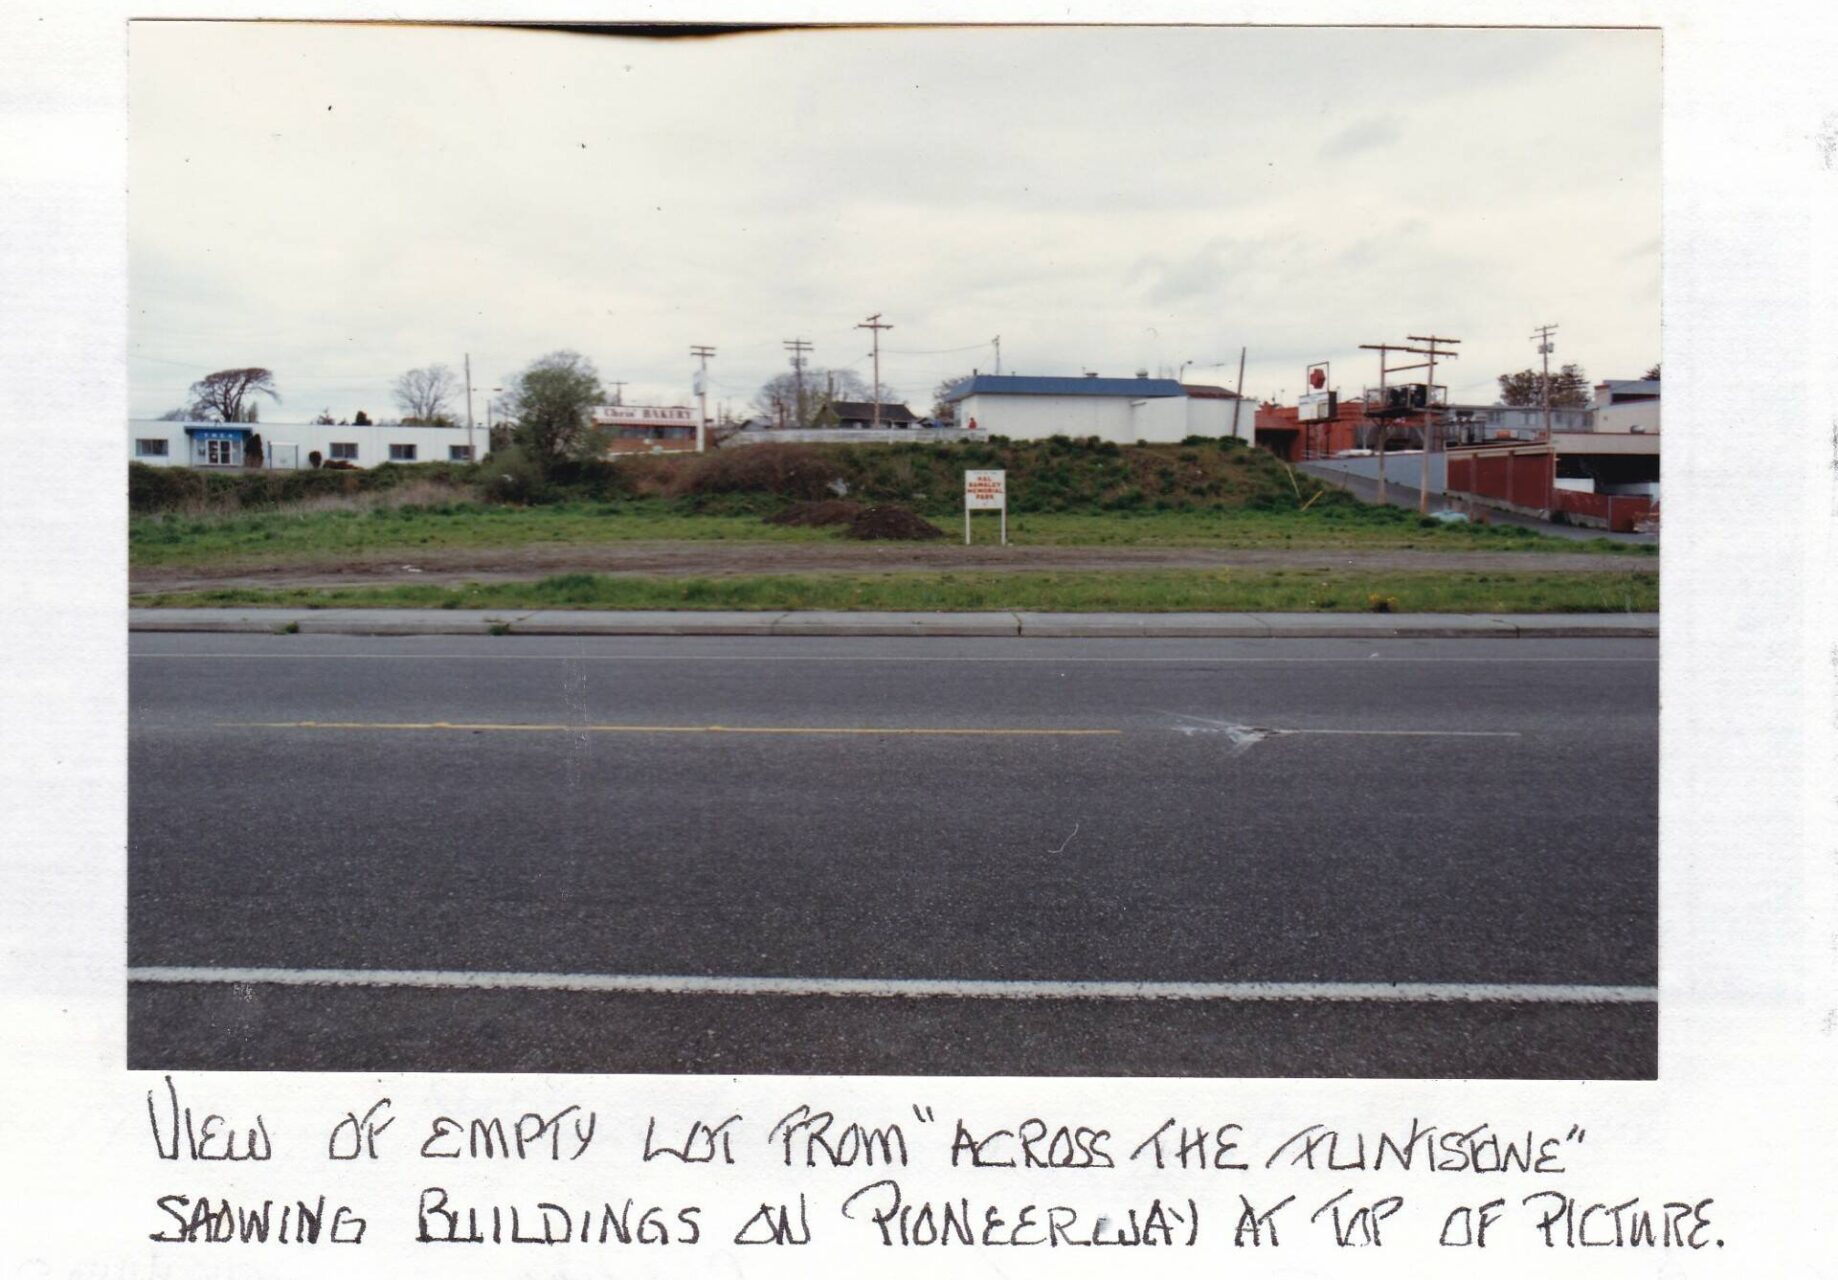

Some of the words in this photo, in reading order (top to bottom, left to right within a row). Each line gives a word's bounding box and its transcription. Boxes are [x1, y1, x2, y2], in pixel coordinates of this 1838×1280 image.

[643, 409, 691, 419] BAKERY
[329, 1098, 396, 1160] OF
[420, 1104, 597, 1160] EMPTY
[643, 1114, 742, 1163] LOT
[1130, 1118, 1250, 1169] THE
[415, 1187, 702, 1245] BUILDINGS
[733, 1193, 811, 1245] ON
[1233, 1194, 1297, 1247] AT
[1310, 1189, 1404, 1248] TOP
[1439, 1199, 1505, 1247] OF
[1522, 1191, 1725, 1249] PICTURE.
